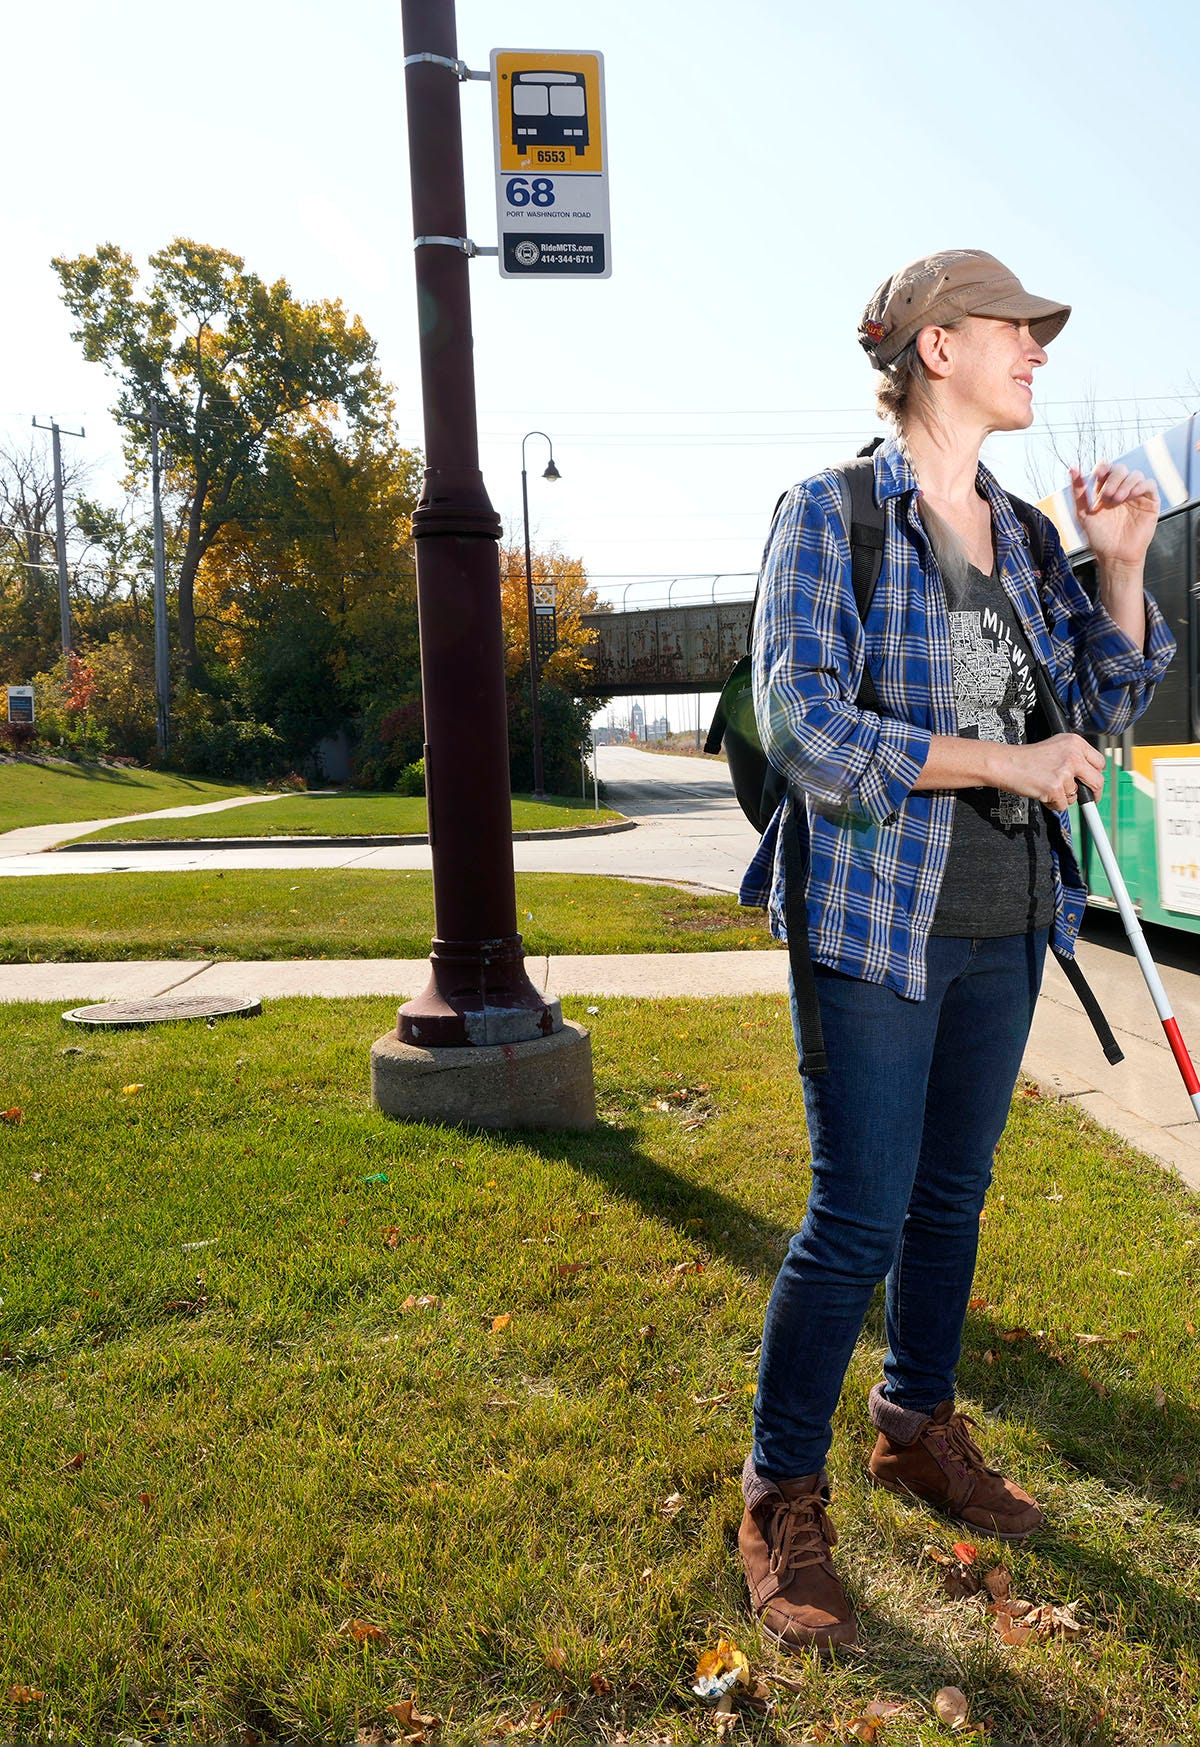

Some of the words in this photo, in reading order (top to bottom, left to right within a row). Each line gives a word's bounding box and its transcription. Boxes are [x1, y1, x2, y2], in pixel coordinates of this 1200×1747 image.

[537, 150, 566, 163] 6553
[506, 177, 556, 207] 68
[540, 243, 594, 252] RideMCTS.com
[982, 607, 1039, 715] MILWAUK
